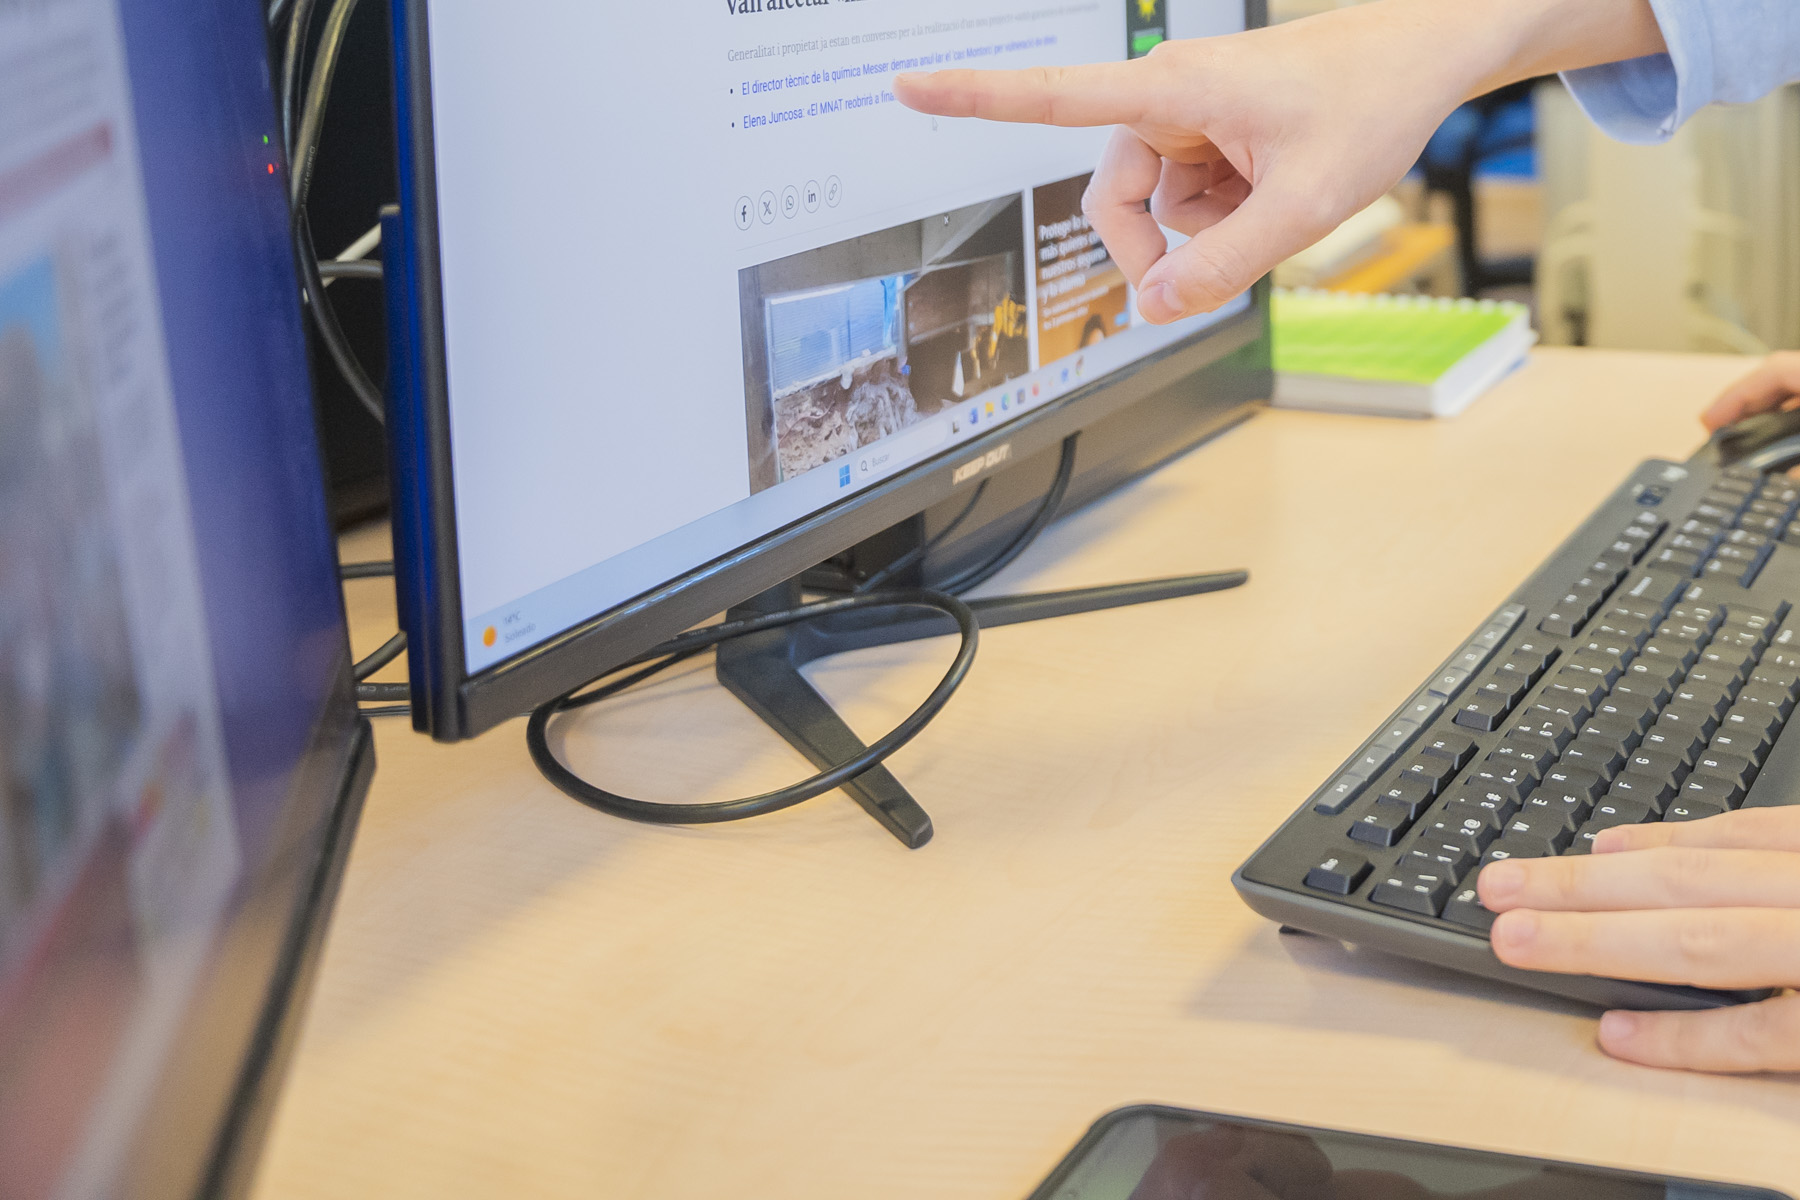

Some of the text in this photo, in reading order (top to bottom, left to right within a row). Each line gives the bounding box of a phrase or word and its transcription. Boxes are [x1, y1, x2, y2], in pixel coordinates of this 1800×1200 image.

[727, 44, 776, 62] Generalitat
[782, 40, 819, 57] propietat
[820, 37, 828, 52] ja
[829, 36, 850, 48] estan
[851, 35, 861, 44] en
[862, 30, 897, 43] converses
[898, 29, 910, 40] per
[742, 81, 750, 96] El
[752, 78, 784, 94] director
[785, 73, 810, 89] tècnic
[811, 72, 821, 84] de
[822, 69, 830, 82] la
[831, 66, 861, 83] química
[862, 61, 889, 76] Messer
[890, 56, 919, 71] demana
[743, 113, 767, 129] Elena
[768, 107, 805, 124] Juncosa:
[807, 102, 818, 117] «El
[820, 98, 844, 115] MNAT
[845, 93, 873, 110] reobrirà
[881, 89, 896, 103] fina
[872, 453, 890, 468] Buscar
[952, 456, 985, 486] KEEP
[505, 622, 536, 643] Soleado
[1679, 692, 1694, 700] K
[1602, 705, 1617, 713] U
[1539, 730, 1553, 738] 6
[1650, 734, 1665, 743] H
[1717, 736, 1732, 744] N
[1635, 757, 1650, 765] G
[1703, 759, 1718, 767] B
[1411, 764, 1424, 772] F3
[1552, 773, 1567, 781] R
[1618, 781, 1632, 789] F
[1688, 782, 1704, 790] V
[1389, 789, 1401, 797] F2
[1486, 792, 1502, 802] #
[1532, 798, 1548, 806] E
[1563, 795, 1577, 803] €
[1480, 801, 1495, 809] 3
[1601, 806, 1616, 814] D
[1674, 807, 1689, 815] C
[1364, 815, 1377, 823] F1
[1464, 818, 1481, 829] @
[1512, 821, 1530, 832] W
[1460, 828, 1475, 836] 2
[1583, 832, 1597, 840] S
[1492, 850, 1510, 859] Q
